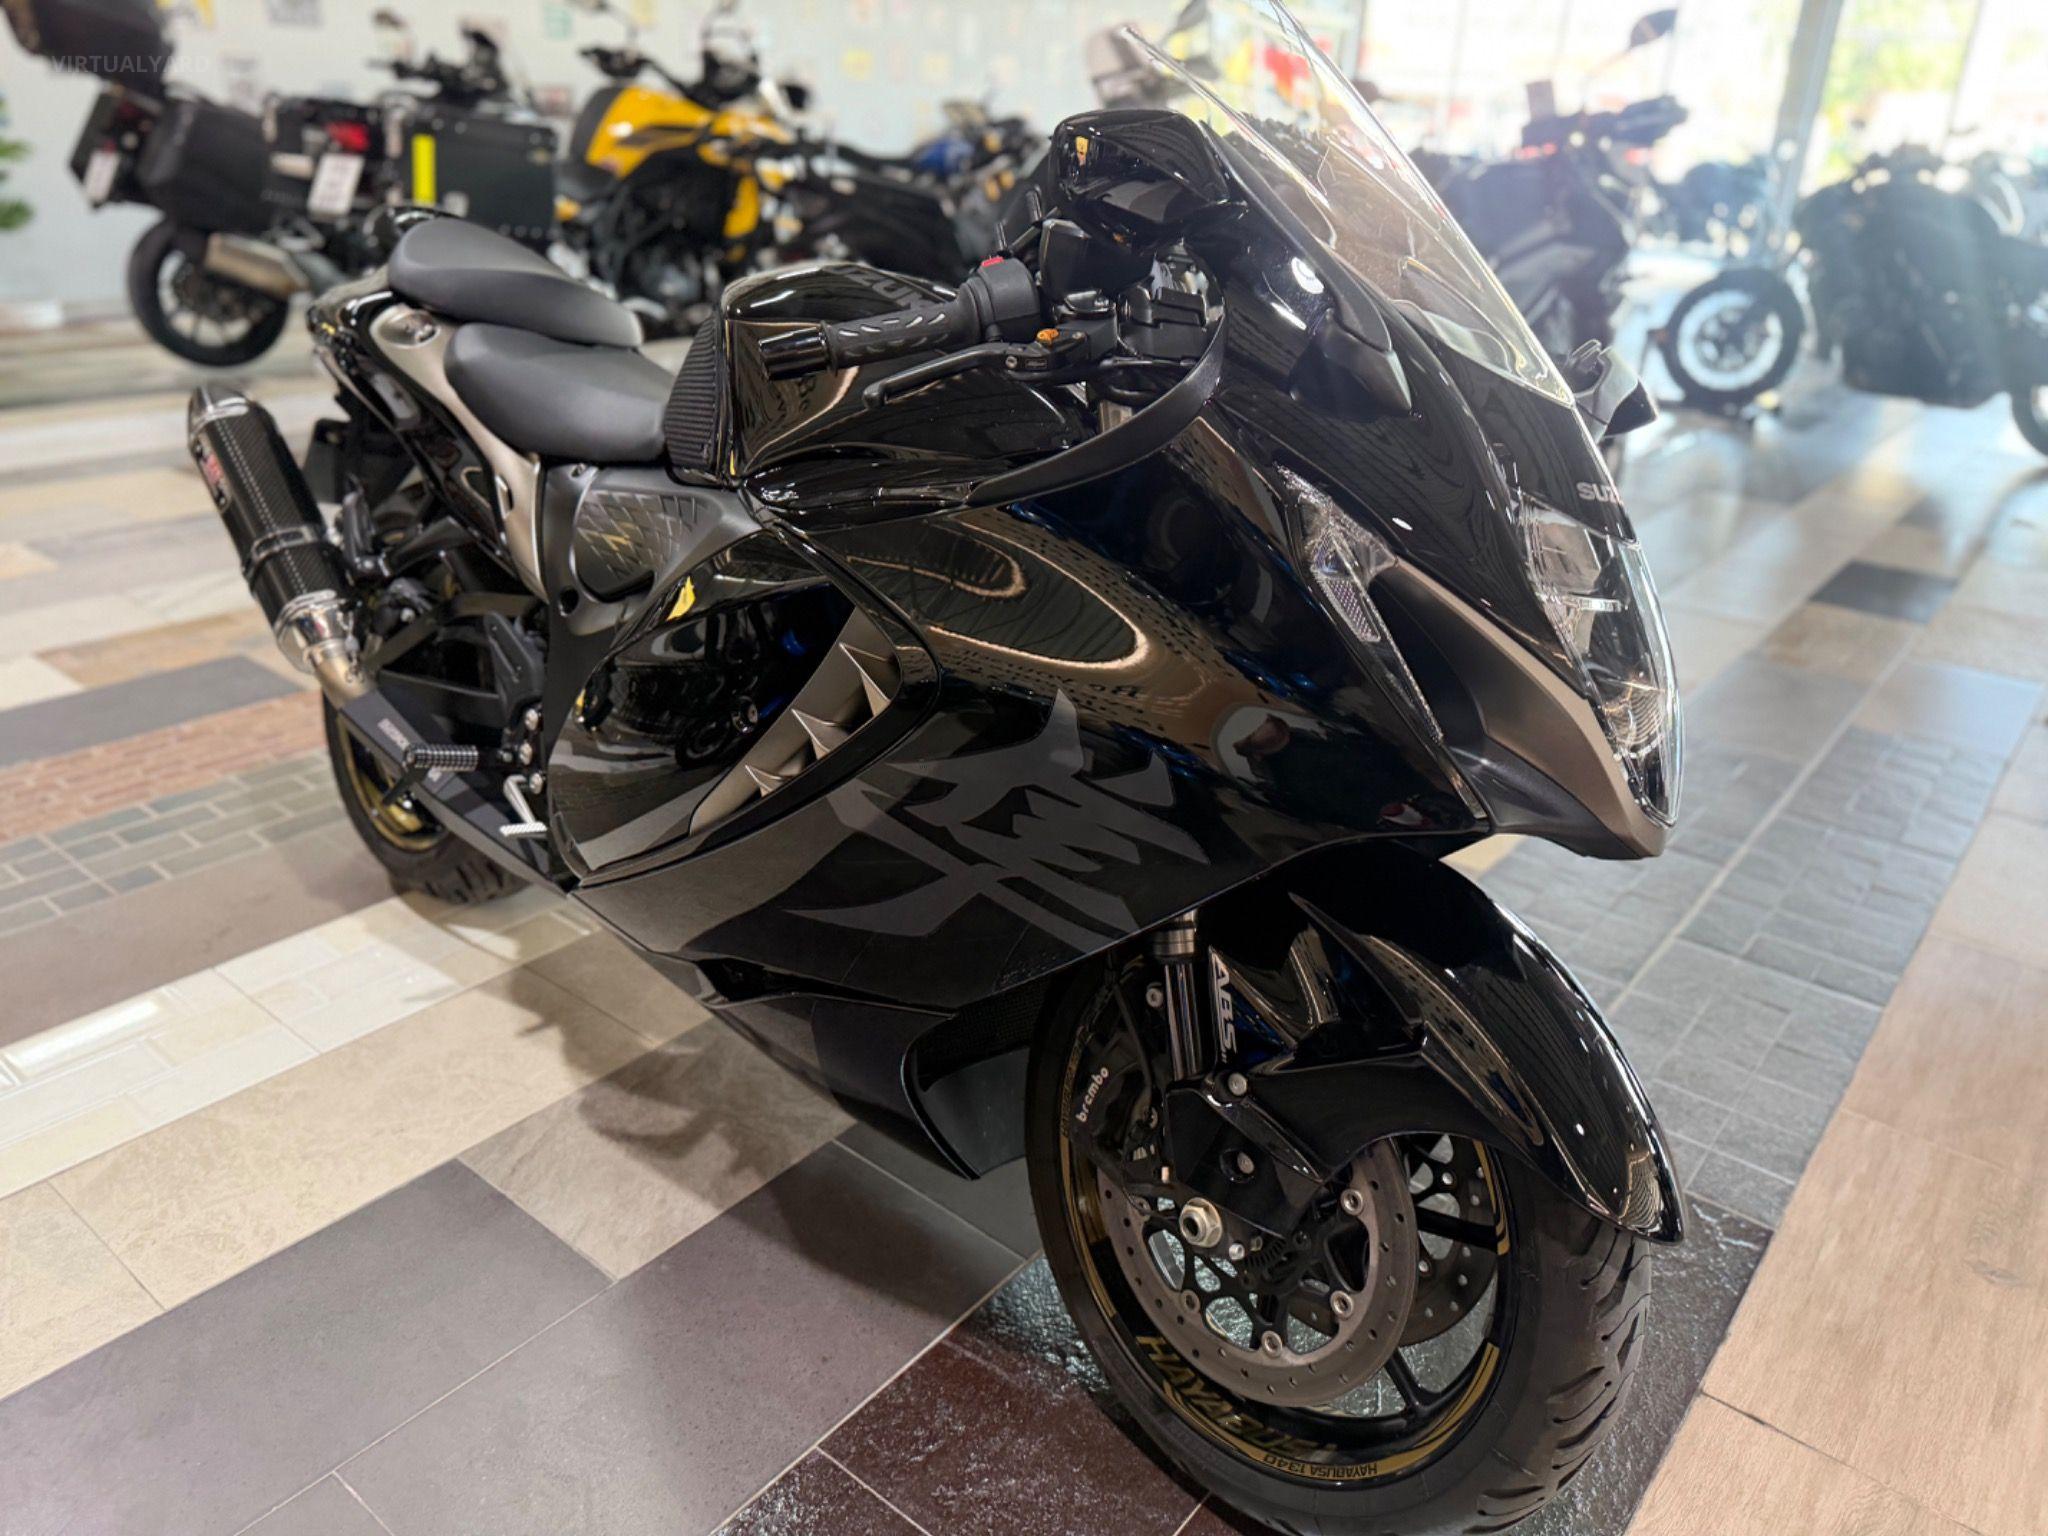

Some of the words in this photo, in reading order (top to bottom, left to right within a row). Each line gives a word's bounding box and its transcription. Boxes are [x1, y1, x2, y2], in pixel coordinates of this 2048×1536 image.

[1211, 951, 1239, 1056] ABS
[1263, 1453, 1306, 1474] 1340
[1309, 1461, 1378, 1478] HAYABUSA
